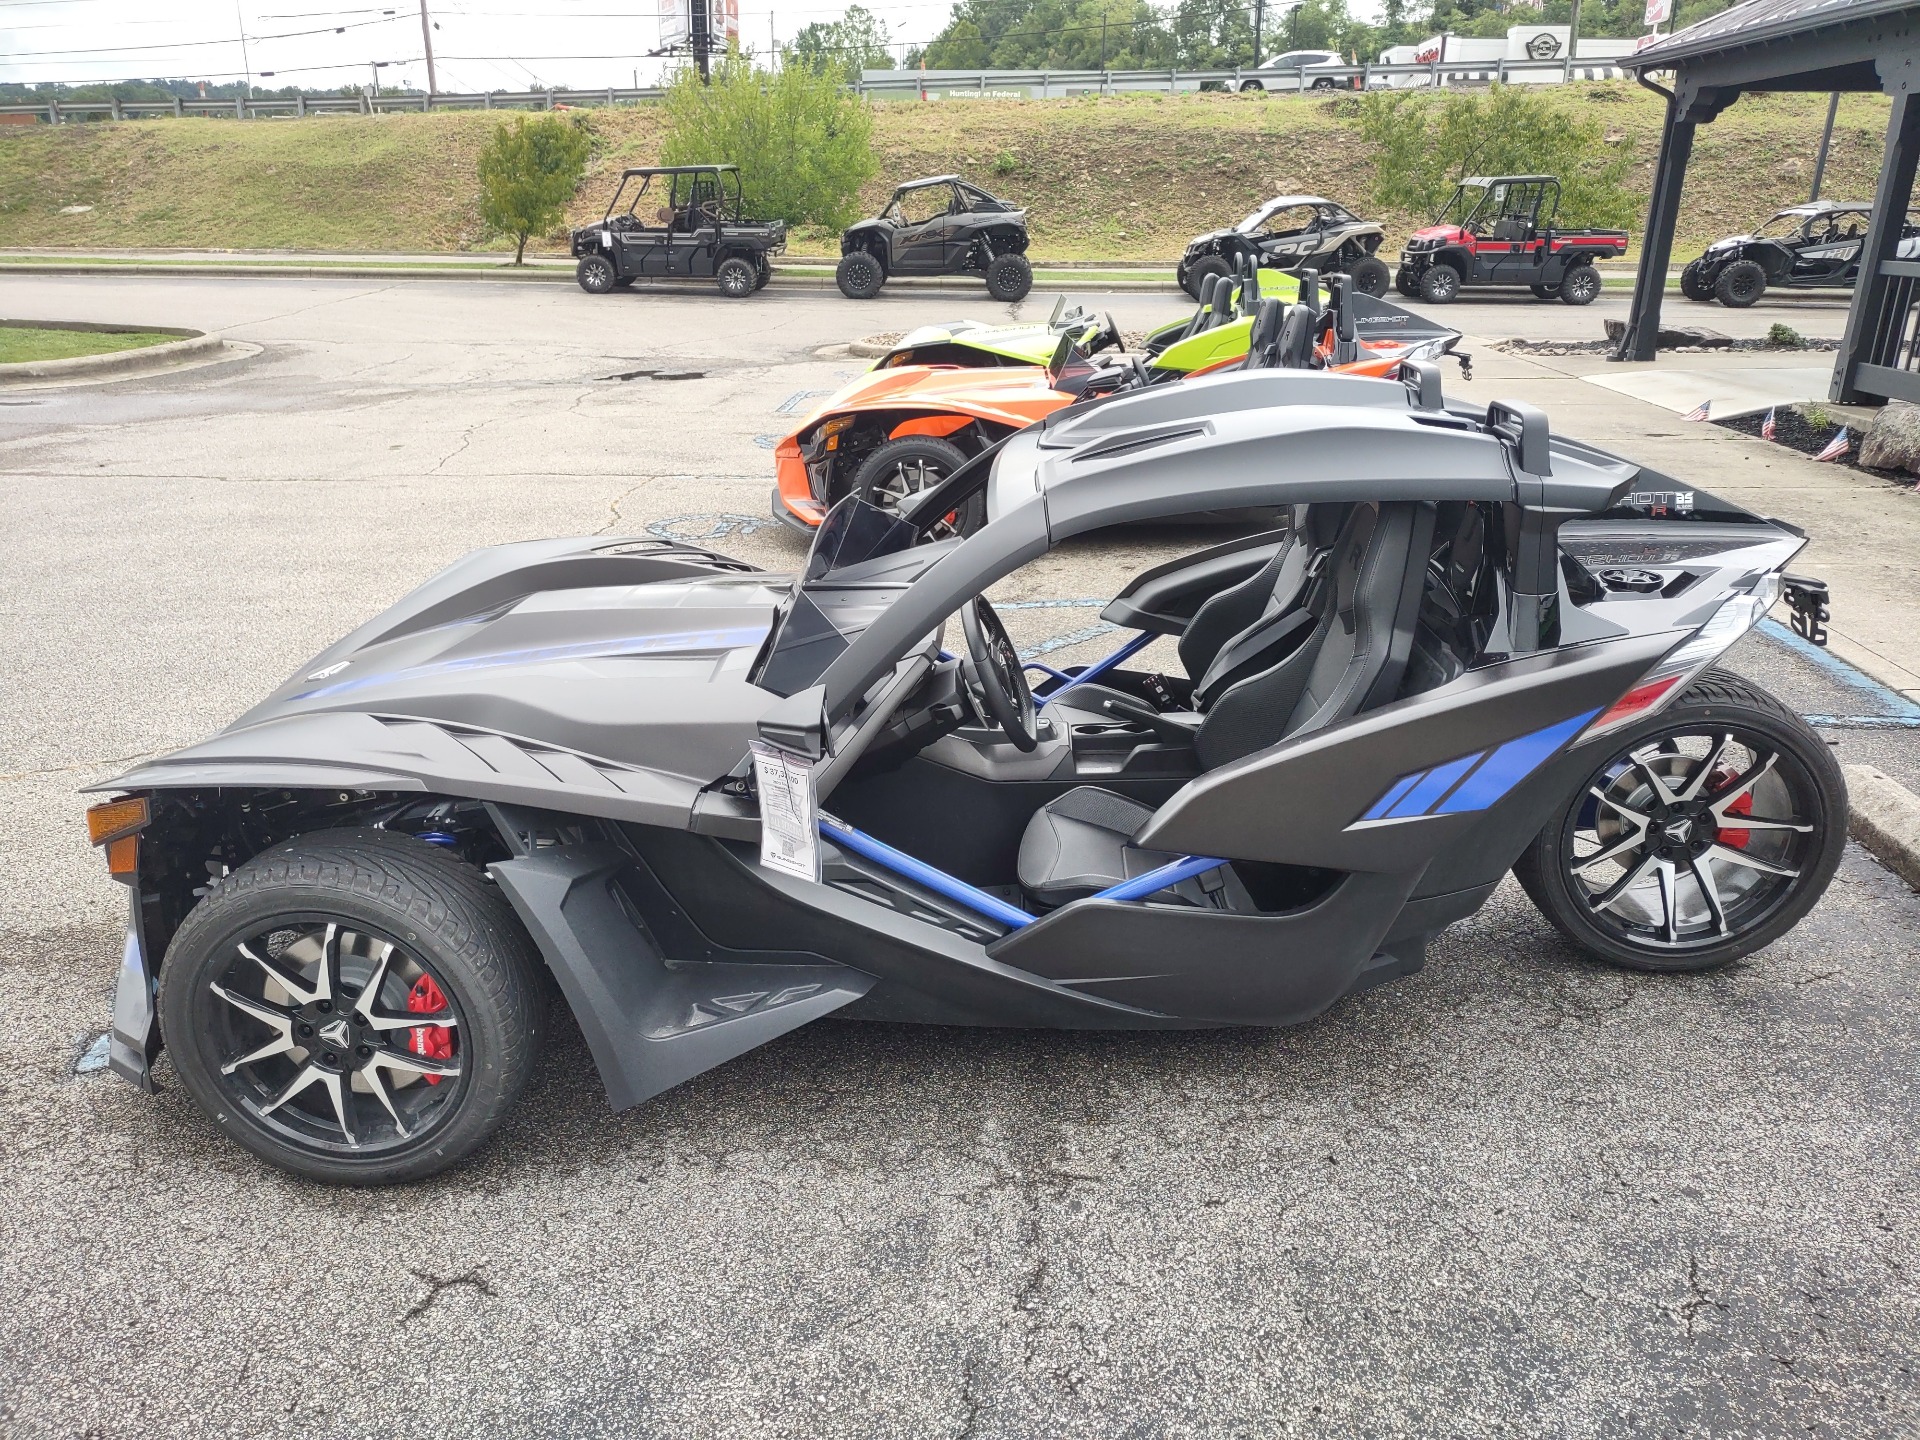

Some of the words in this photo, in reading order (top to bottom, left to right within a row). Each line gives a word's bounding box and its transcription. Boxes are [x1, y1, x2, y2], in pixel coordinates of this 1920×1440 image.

[949, 89, 991, 99] Huntingtn
[992, 90, 1021, 98] Federal
[1650, 504, 1667, 517] R
